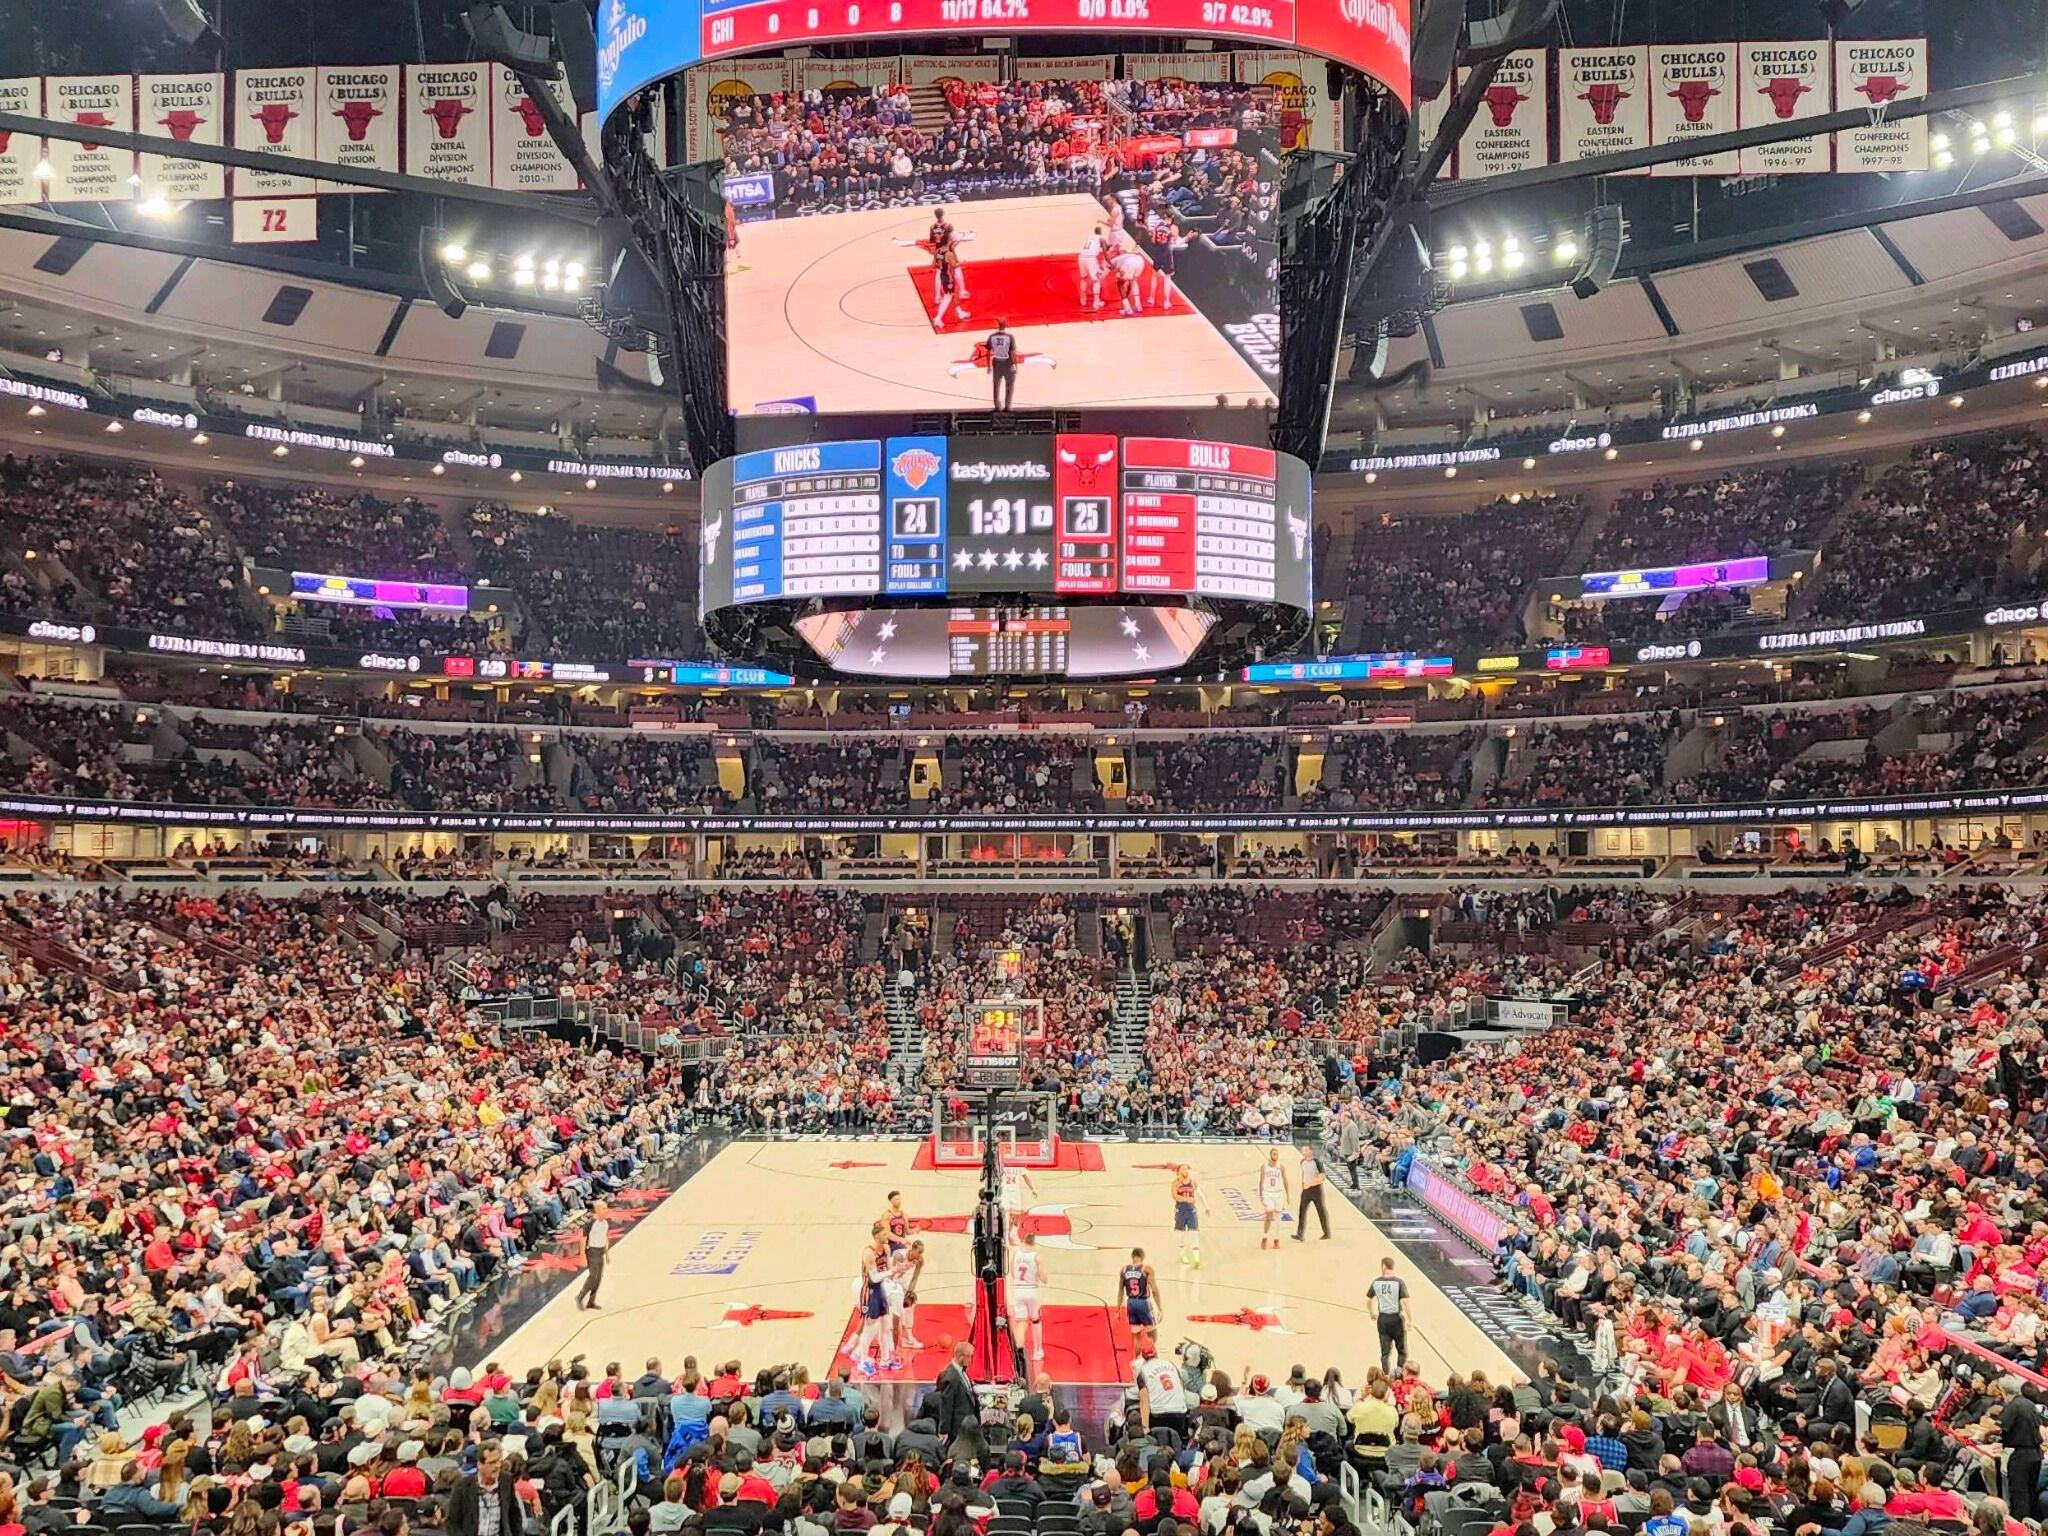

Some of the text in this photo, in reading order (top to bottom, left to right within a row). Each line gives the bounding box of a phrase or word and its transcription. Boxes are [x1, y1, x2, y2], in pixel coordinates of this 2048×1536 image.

[712, 16, 734, 44] CHI
[1202, 4, 1226, 24] 3/7
[1230, 6, 1272, 28] 42.9%
[1661, 52, 1725, 64] CHICAGO
[1751, 50, 1817, 63] CHICAGO
[1849, 48, 1914, 59] CHICAGO
[1571, 55, 1636, 67] CHICAGO
[1671, 67, 1717, 79] BULLS
[1762, 64, 1808, 76] BULLS
[1859, 62, 1905, 73] BULLS
[328, 74, 388, 86] CHICAGO
[418, 71, 478, 83] CHICAGO
[1582, 69, 1628, 81] BULLS
[152, 82, 212, 94] CHICAGO
[246, 76, 304, 88] CHICAGO
[59, 84, 120, 96] CHICAGO
[255, 90, 297, 101] BULLS
[337, 88, 380, 99] BULLS
[428, 86, 470, 96] BULLS
[69, 98, 112, 109] BULLS
[162, 96, 204, 107] BULLS
[1484, 129, 1521, 137] EASTERN
[1587, 126, 1624, 135] EASTERN
[1676, 123, 1712, 131] EASTERN
[1854, 132, 1911, 141] CONFERENCE
[340, 144, 375, 152] CENTRAL
[430, 142, 466, 150] CENTRAL
[518, 140, 553, 148] CENTRAL
[1475, 140, 1530, 149] CONFERENCE
[1854, 144, 1909, 153] CHAMPIONS
[517, 151, 555, 160] DIVISION
[1477, 151, 1530, 160] CHAMPIONS
[1758, 146, 1813, 155] CHAMPIONS
[338, 155, 376, 164] DIVISION
[430, 154, 468, 162] DIVISION
[424, 164, 474, 174] CHAMPIONS
[510, 163, 562, 172] CHAMPIONS
[262, 209, 287, 232] 72
[1662, 403, 1818, 440] ULTRA PREMIUM VODKA
[774, 448, 820, 473] KNICKS
[1189, 444, 1230, 469] BULLS
[651, 466, 691, 480] VODKA
[1144, 475, 1177, 488] PLAYERS
[1137, 496, 1161, 507] WHITE
[903, 503, 927, 532] 24
[968, 498, 1026, 534] 1:31
[1074, 502, 1098, 532] 25
[891, 545, 904, 558] TO
[1062, 544, 1075, 557] TO
[1126, 556, 1136, 566] 24
[891, 565, 936, 578] FOULS 1
[1061, 563, 1108, 577] FOULS 1
[1760, 619, 1925, 650] ULTRA PREMIUM VODKA
[736, 670, 766, 682] CLUB
[1310, 664, 1342, 676] CLUB
[1512, 1008, 1548, 1020] Advocate
[981, 1057, 1018, 1066] TISSOT
[1006, 1176, 1016, 1185] 24
[1018, 1266, 1028, 1281] 7
[1130, 1278, 1140, 1296] 5
